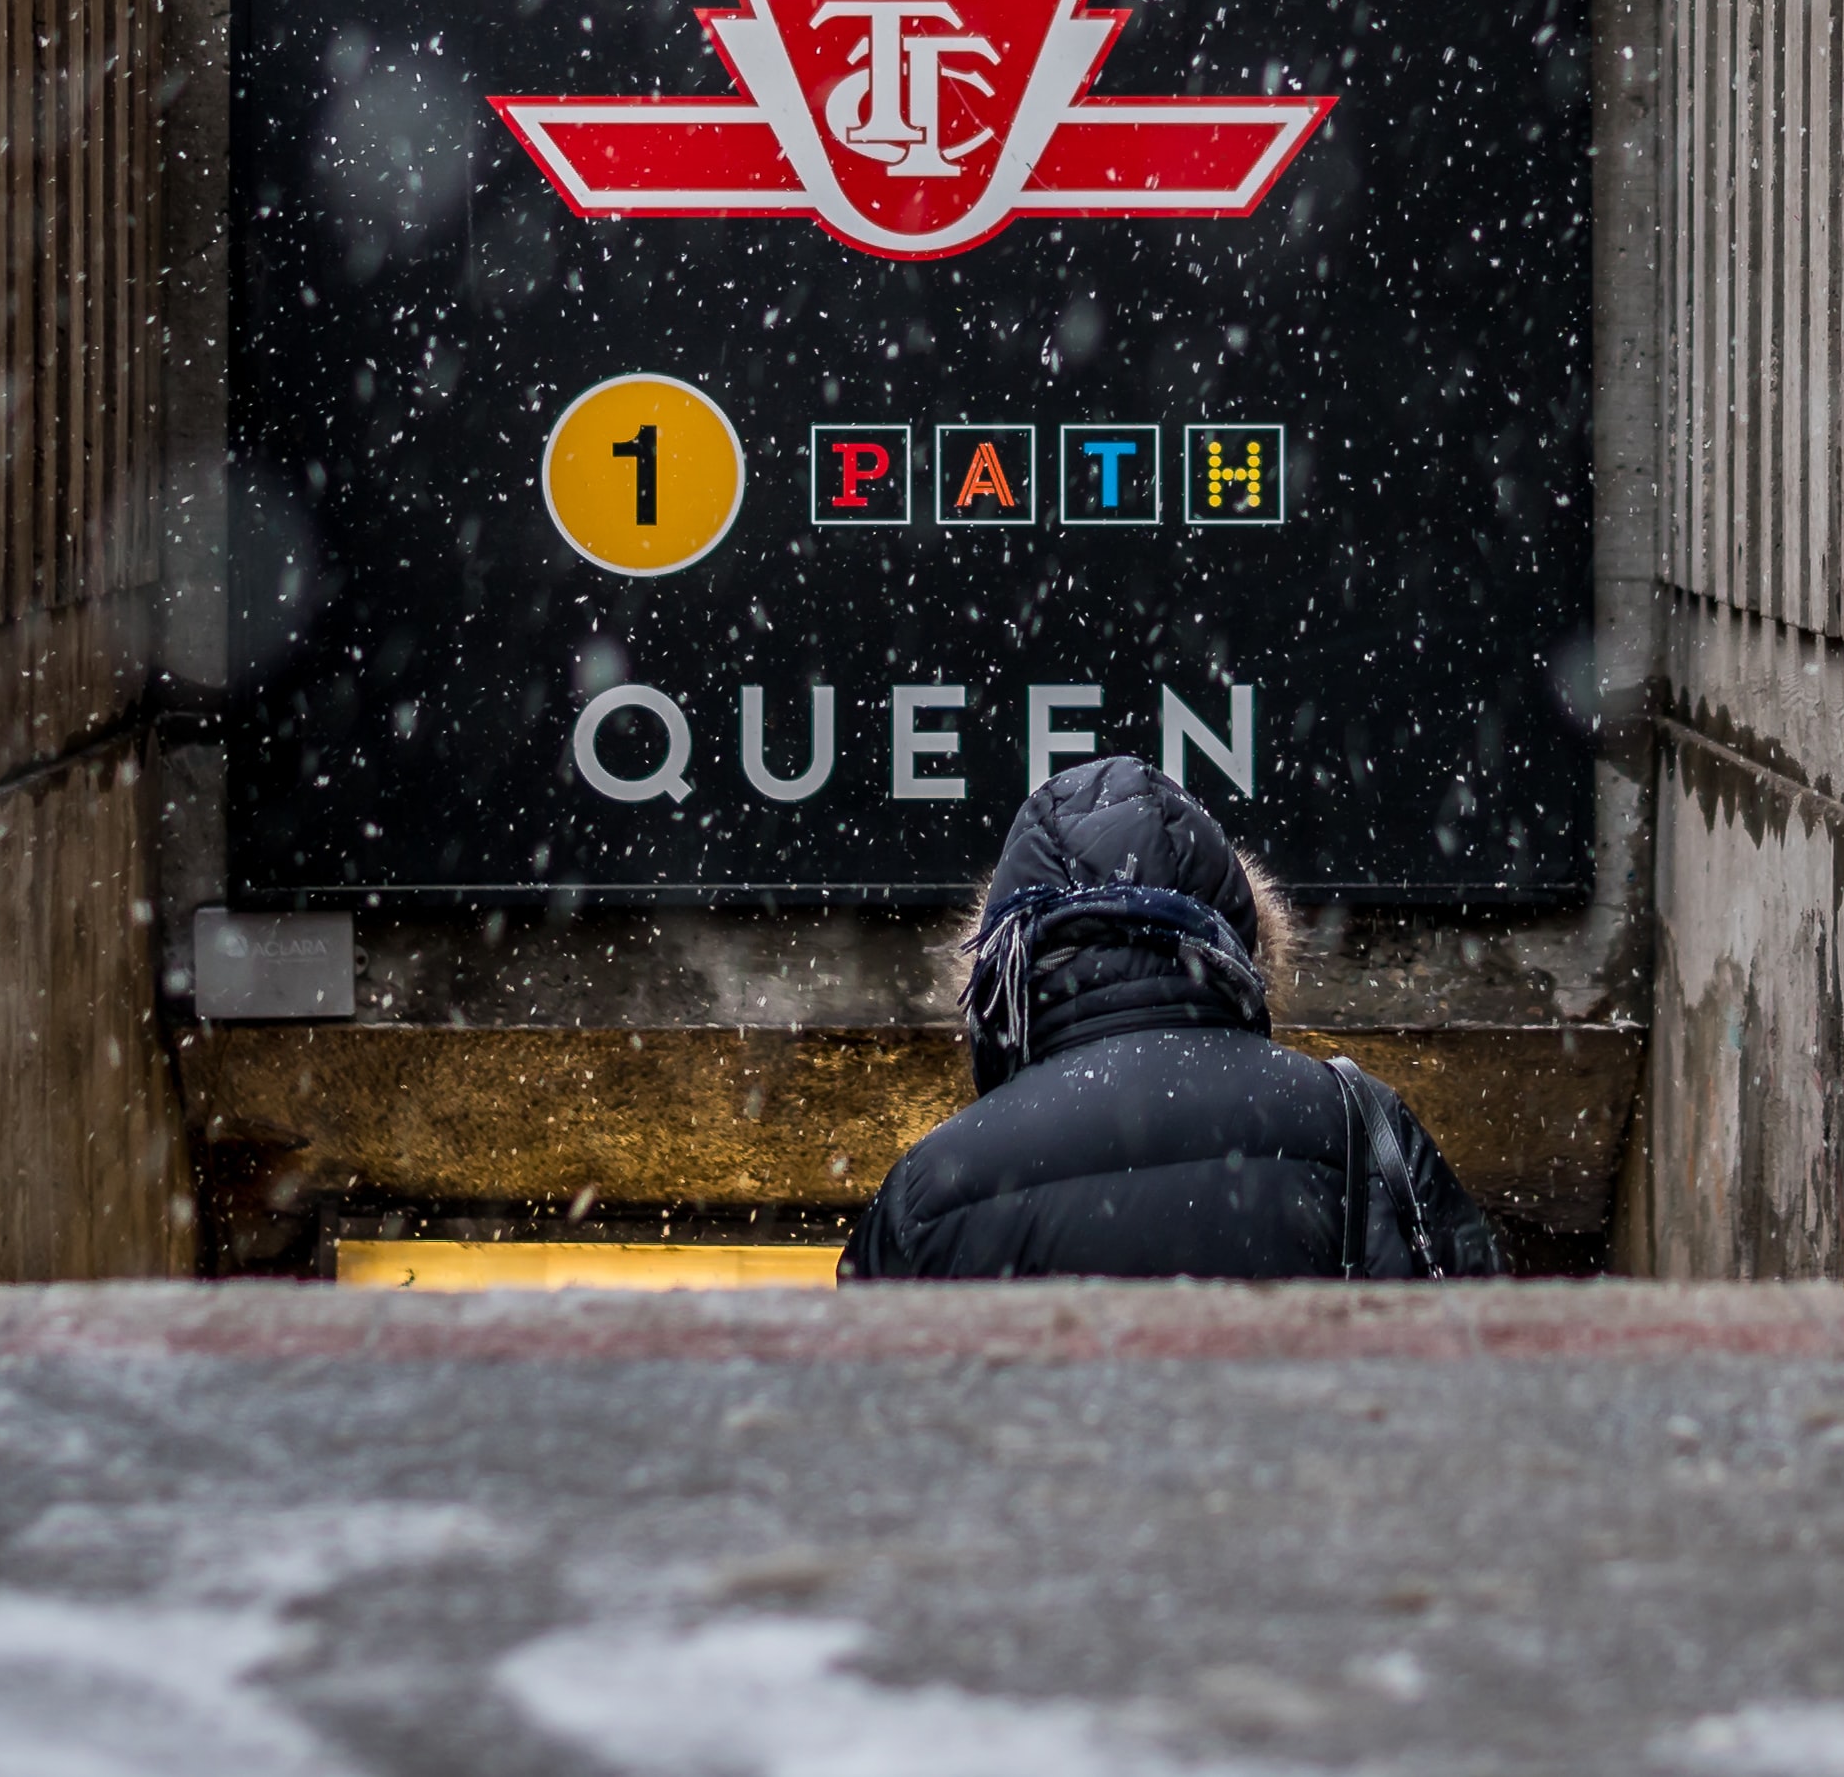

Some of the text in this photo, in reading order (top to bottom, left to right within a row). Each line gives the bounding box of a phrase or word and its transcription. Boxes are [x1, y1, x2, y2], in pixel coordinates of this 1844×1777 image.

[611, 424, 1262, 526] 1 PATH
[573, 683, 1255, 806] QUEEN
[251, 938, 328, 958] ACLARA
